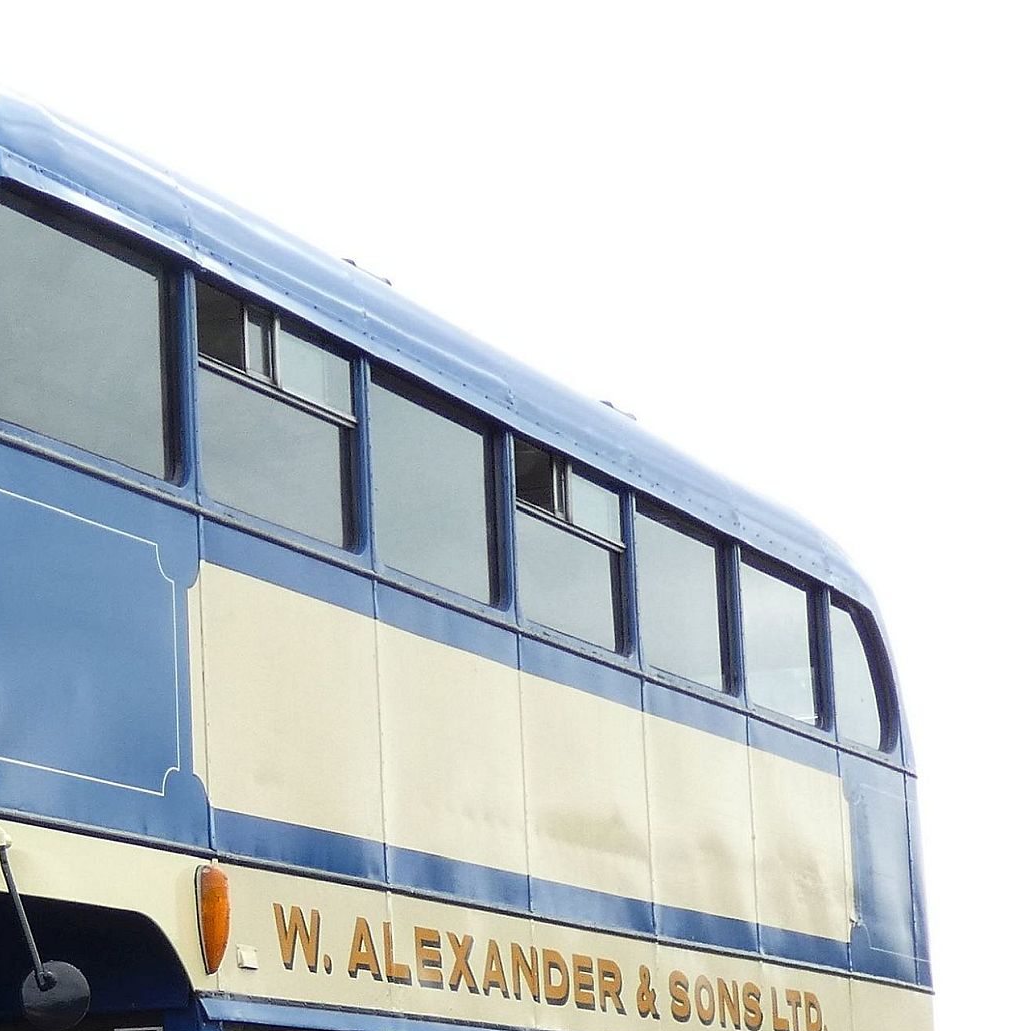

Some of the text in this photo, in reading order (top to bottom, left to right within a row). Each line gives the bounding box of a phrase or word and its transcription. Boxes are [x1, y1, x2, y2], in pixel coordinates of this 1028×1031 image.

[272, 902, 332, 975] W.
[347, 916, 627, 1016] ALEXANDER
[637, 964, 661, 1020] &
